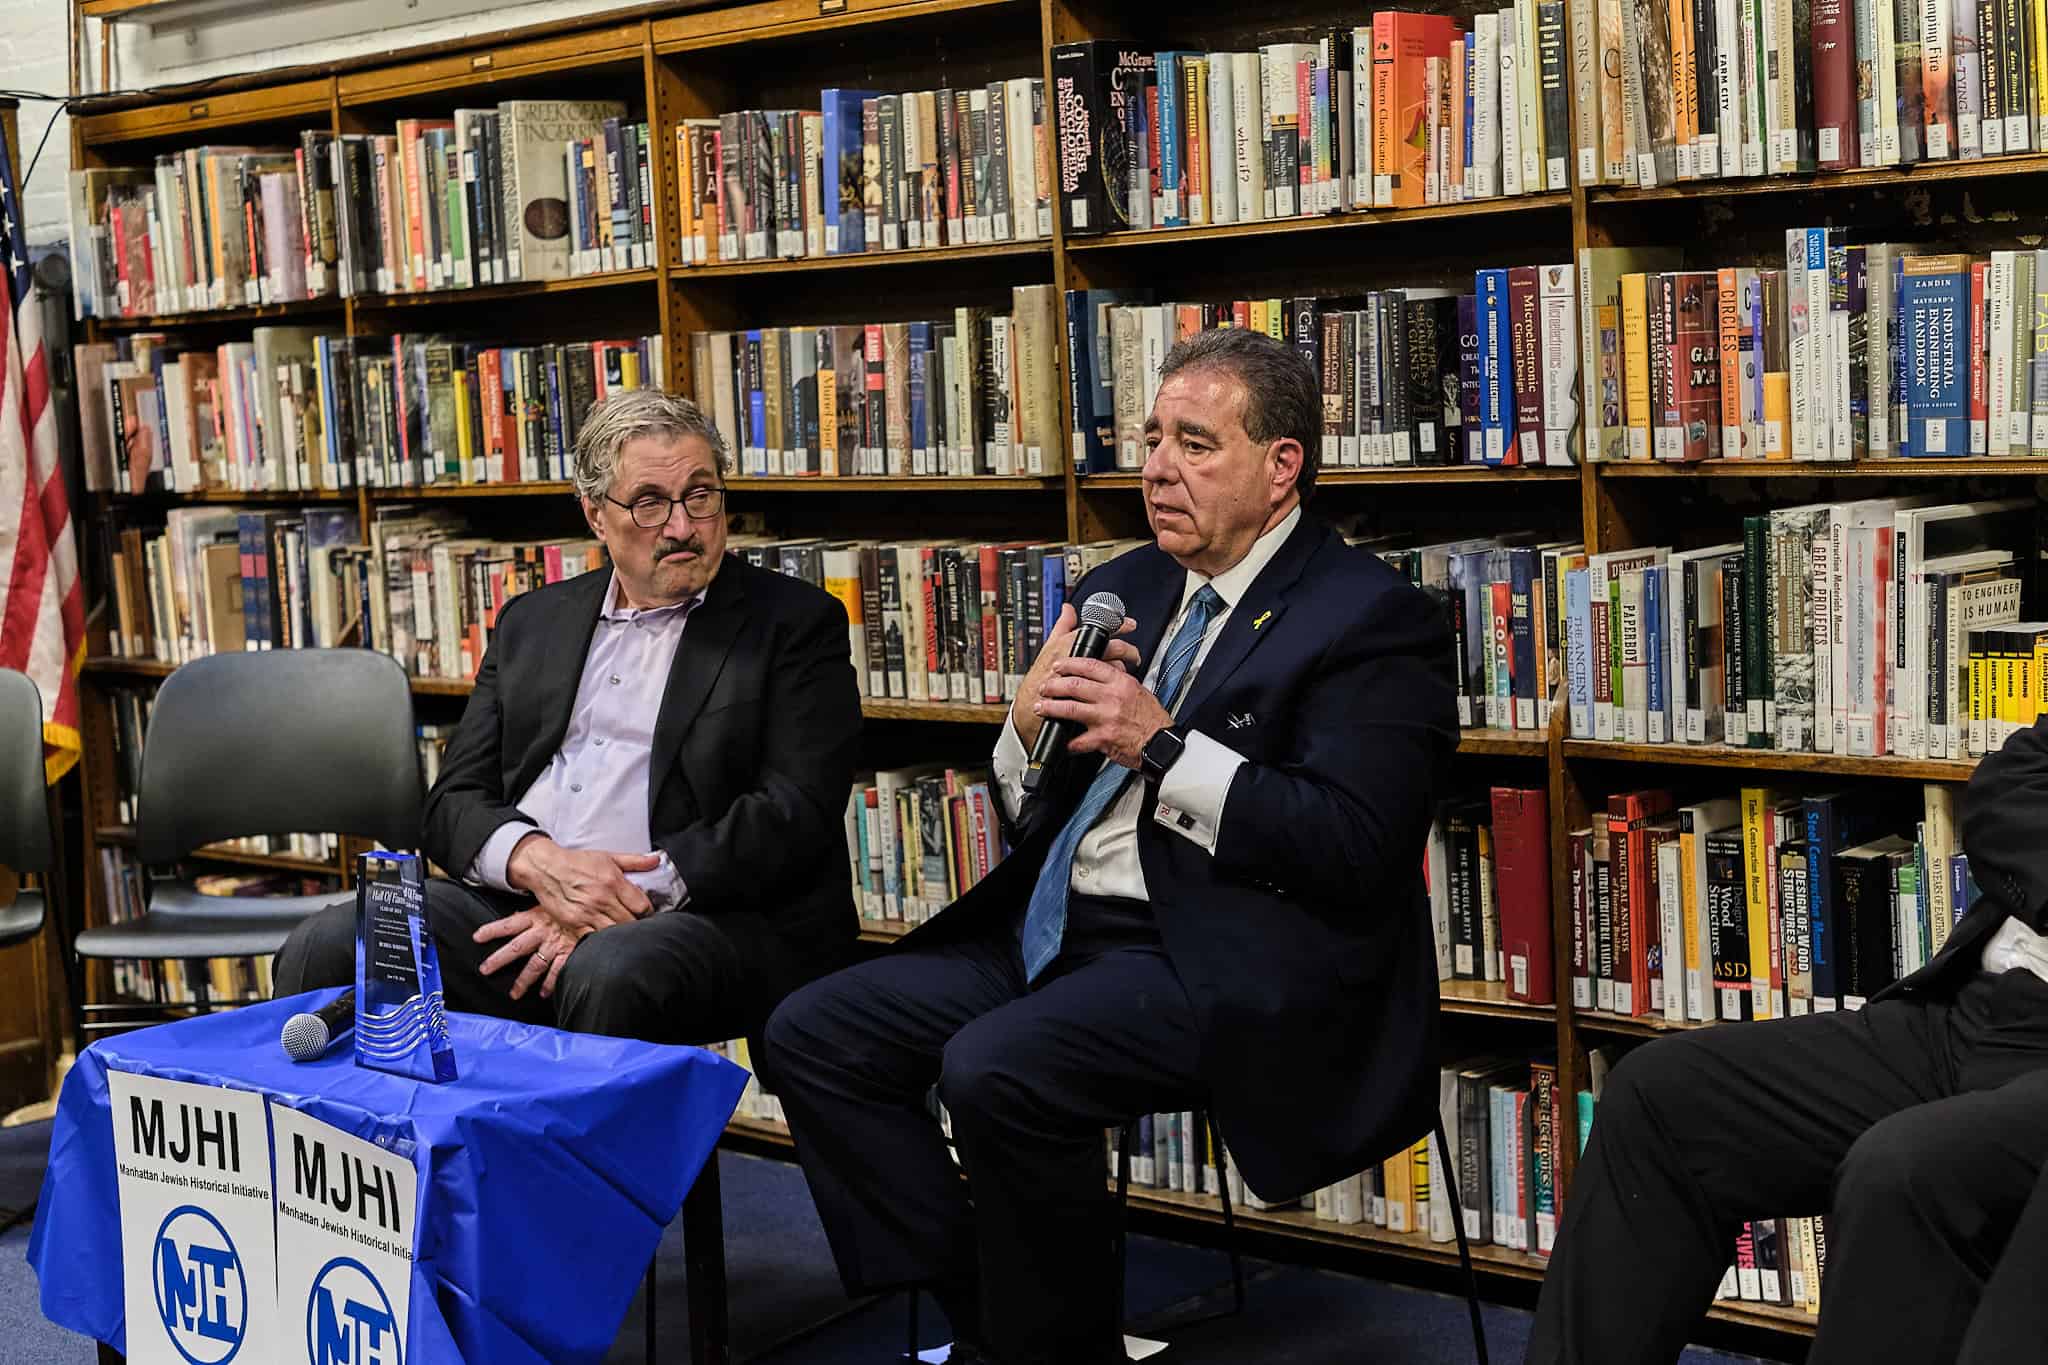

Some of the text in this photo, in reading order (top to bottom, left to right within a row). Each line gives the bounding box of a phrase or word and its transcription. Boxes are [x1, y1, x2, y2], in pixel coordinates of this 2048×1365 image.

[1984, 4, 1993, 26] NOT
[1985, 31, 1994, 44] BY
[1478, 47, 1489, 105] BEAUTIFUL
[1673, 50, 1683, 116] VIZCAYA
[1719, 53, 1729, 111] FARM CITY
[1929, 47, 1942, 72] Fire
[1987, 59, 1996, 88] LONG
[991, 92, 1004, 157] MILTON
[1058, 91, 1068, 127] SCIENCE
[1063, 76, 1080, 193] ENCYCLOPEDIA
[1073, 94, 1087, 174] CONCISE
[1378, 69, 1390, 174] Pattern Classification
[1478, 111, 1490, 142] MIND
[1988, 91, 1998, 119] SHOT
[1060, 135, 1072, 193] TECHNOLOGY
[1236, 127, 1250, 183] what if?
[1582, 267, 1591, 306] INVENTING
[1915, 280, 1952, 289] ZANDIN
[1994, 299, 2002, 332] THINGS
[1298, 311, 1313, 344] Carl
[1521, 294, 1539, 393] Microelectronic
[1584, 307, 1592, 334] MODERN
[1585, 335, 1593, 365] AMERICA
[1655, 312, 1665, 367] CULTURE
[1663, 281, 1675, 407] GADGET NATION
[1721, 289, 1737, 353] CIRCLES
[1793, 266, 1806, 424] THE WAY THINGS WOR
[1811, 276, 1822, 392] HOW THINGS WORK TODAY
[1871, 302, 1883, 353] TEXTURE
[1915, 308, 1927, 387] HANDBOOK
[1943, 307, 1955, 388] INDUSTRIAL
[1122, 330, 1136, 417] SHAKESPEARE
[1513, 322, 1526, 394] Circuit Design
[1649, 312, 1658, 404] IMPROVEMENT
[1929, 308, 1941, 399] ENGINEERING
[1835, 360, 1845, 424] Instrumentation
[1812, 546, 1829, 646] GREAT PROJECTS
[1833, 522, 1844, 645] Construction Materials Manual
[1961, 582, 2020, 601] TO ENGINEER
[1963, 599, 2016, 619] IS HUMAN
[1495, 615, 1506, 667] COOL
[1574, 615, 1589, 705] THE ANCIENT
[1622, 604, 1638, 663] PAPERBOY
[1748, 799, 1761, 905] Timber Construction Manual
[1806, 811, 1821, 844] Steel
[1450, 871, 1461, 915] IS NEAR
[1459, 847, 1473, 941] THE SINGULARITY
[1612, 889, 1621, 924] Historic
[1617, 837, 1631, 953] STRUCTURAL ANALYSIS
[1720, 885, 1734, 928] Wood
[1732, 886, 1745, 937] Design of
[1783, 869, 1797, 944] STRUCTURES
[1809, 845, 1824, 921] Construction
[1572, 869, 1584, 968] The Tower and the Bridge
[1708, 883, 1720, 957] Structures
[1795, 869, 1810, 972] DESIGN OF WOOD
[1713, 961, 1748, 978] ASD
[129, 1095, 241, 1173] MJHI
[1538, 1071, 1554, 1187] Basic Electronics
[118, 1164, 270, 1201] Manhattan Jewish Historical Initiative
[292, 1132, 401, 1234] MJHI
[278, 1200, 416, 1261] Manhattan Jewish Historical Initia
